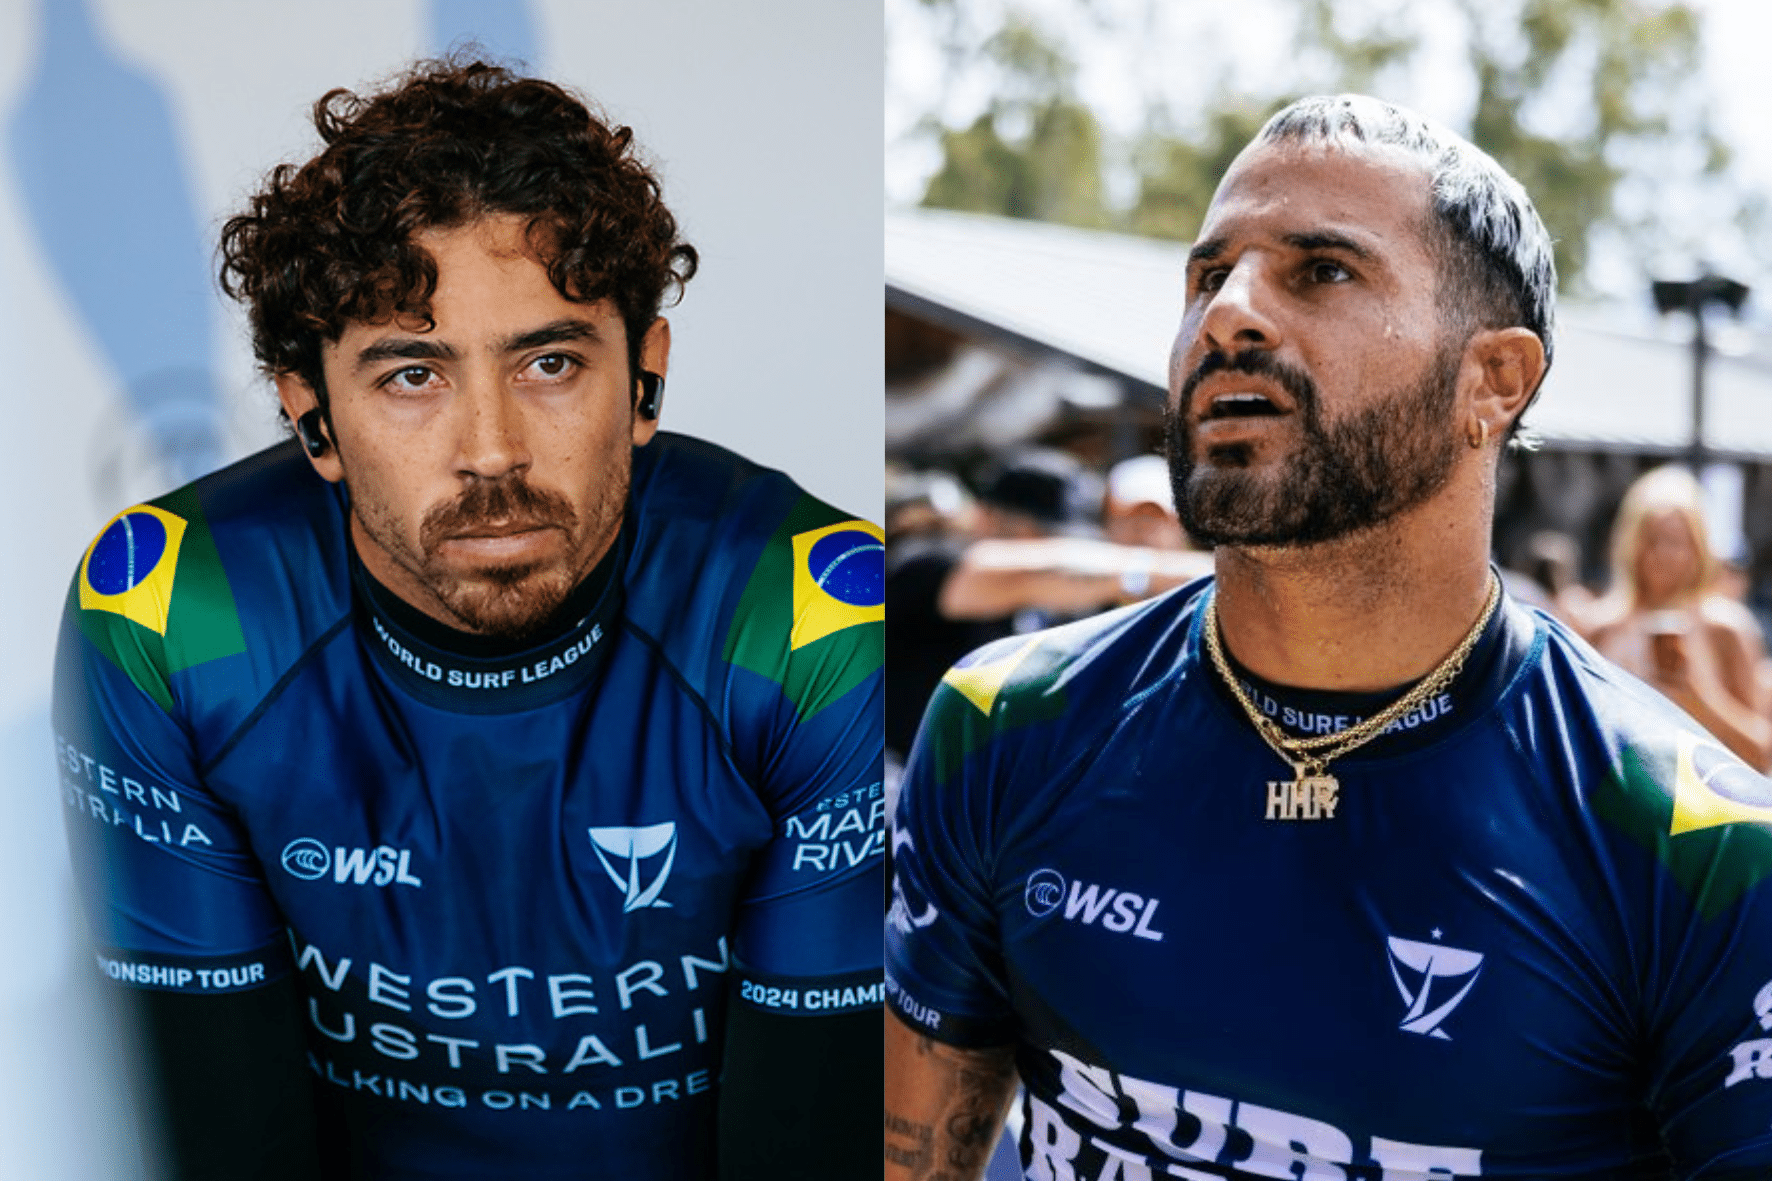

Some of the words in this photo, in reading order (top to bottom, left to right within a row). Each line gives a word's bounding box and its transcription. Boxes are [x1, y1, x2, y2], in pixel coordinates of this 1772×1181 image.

[372, 616, 442, 681] WORLD
[447, 669, 516, 688] SURF
[520, 622, 604, 684] LEAGUE
[1281, 706, 1349, 735] SURF
[334, 845, 422, 888] WSL
[1063, 880, 1164, 941] WSL
[97, 955, 193, 987] ONSHIP
[196, 962, 265, 988] TOUR
[286, 926, 729, 1020] WESTERN
[741, 979, 798, 1009] 2024
[480, 1090, 552, 1110] ON
[567, 1091, 602, 1110] A
[614, 1069, 711, 1109] DRE
